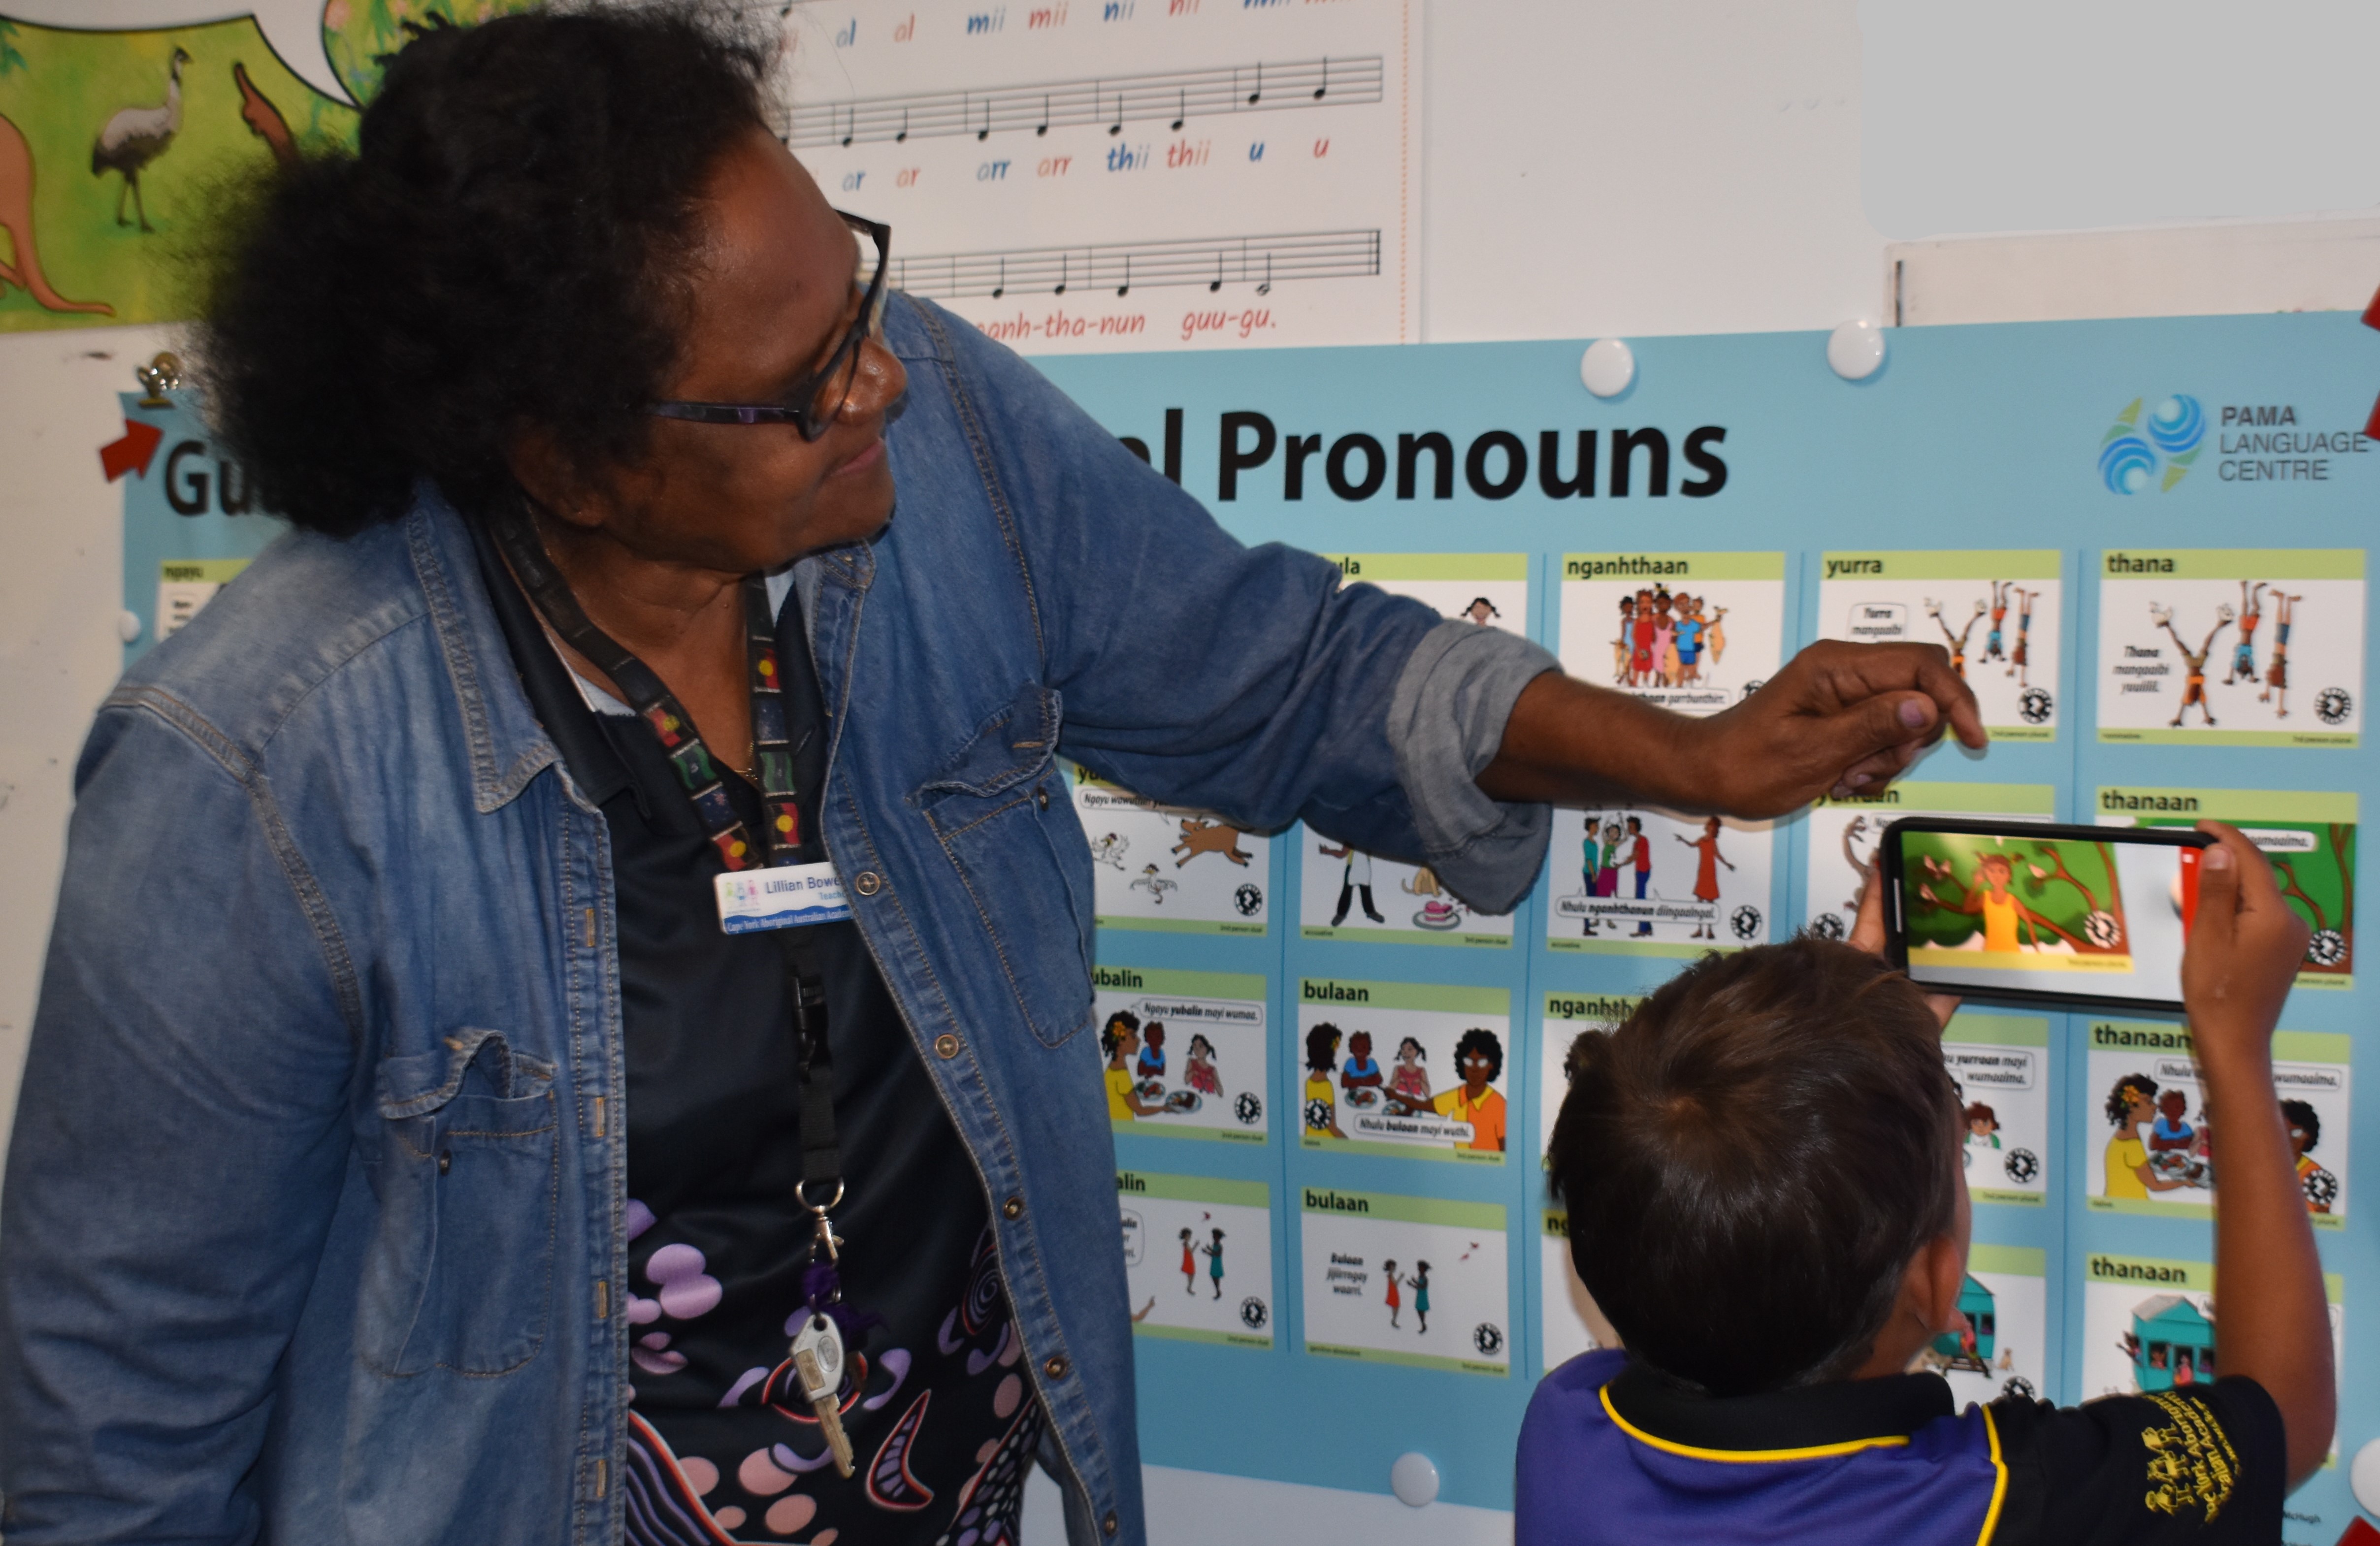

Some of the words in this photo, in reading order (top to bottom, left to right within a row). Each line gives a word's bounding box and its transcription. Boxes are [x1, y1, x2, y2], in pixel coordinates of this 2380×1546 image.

[1249, 142, 1265, 162] u
[1313, 138, 1330, 158] u
[2221, 406, 2297, 427] PAMA
[2219, 432, 2368, 455] LANGUAGE
[1218, 410, 1728, 502] Pronouns
[2218, 459, 2329, 482] CENTRE
[1567, 556, 1689, 579] nganhthaan
[1826, 557, 1884, 579] yurra
[2107, 553, 2175, 573] thana
[2101, 790, 2200, 812] thanaan
[766, 880, 804, 894] Lillian
[1304, 981, 1370, 1002] bulaan
[1305, 1189, 1369, 1212] bulaan
[2091, 1256, 2187, 1283] thanaan
